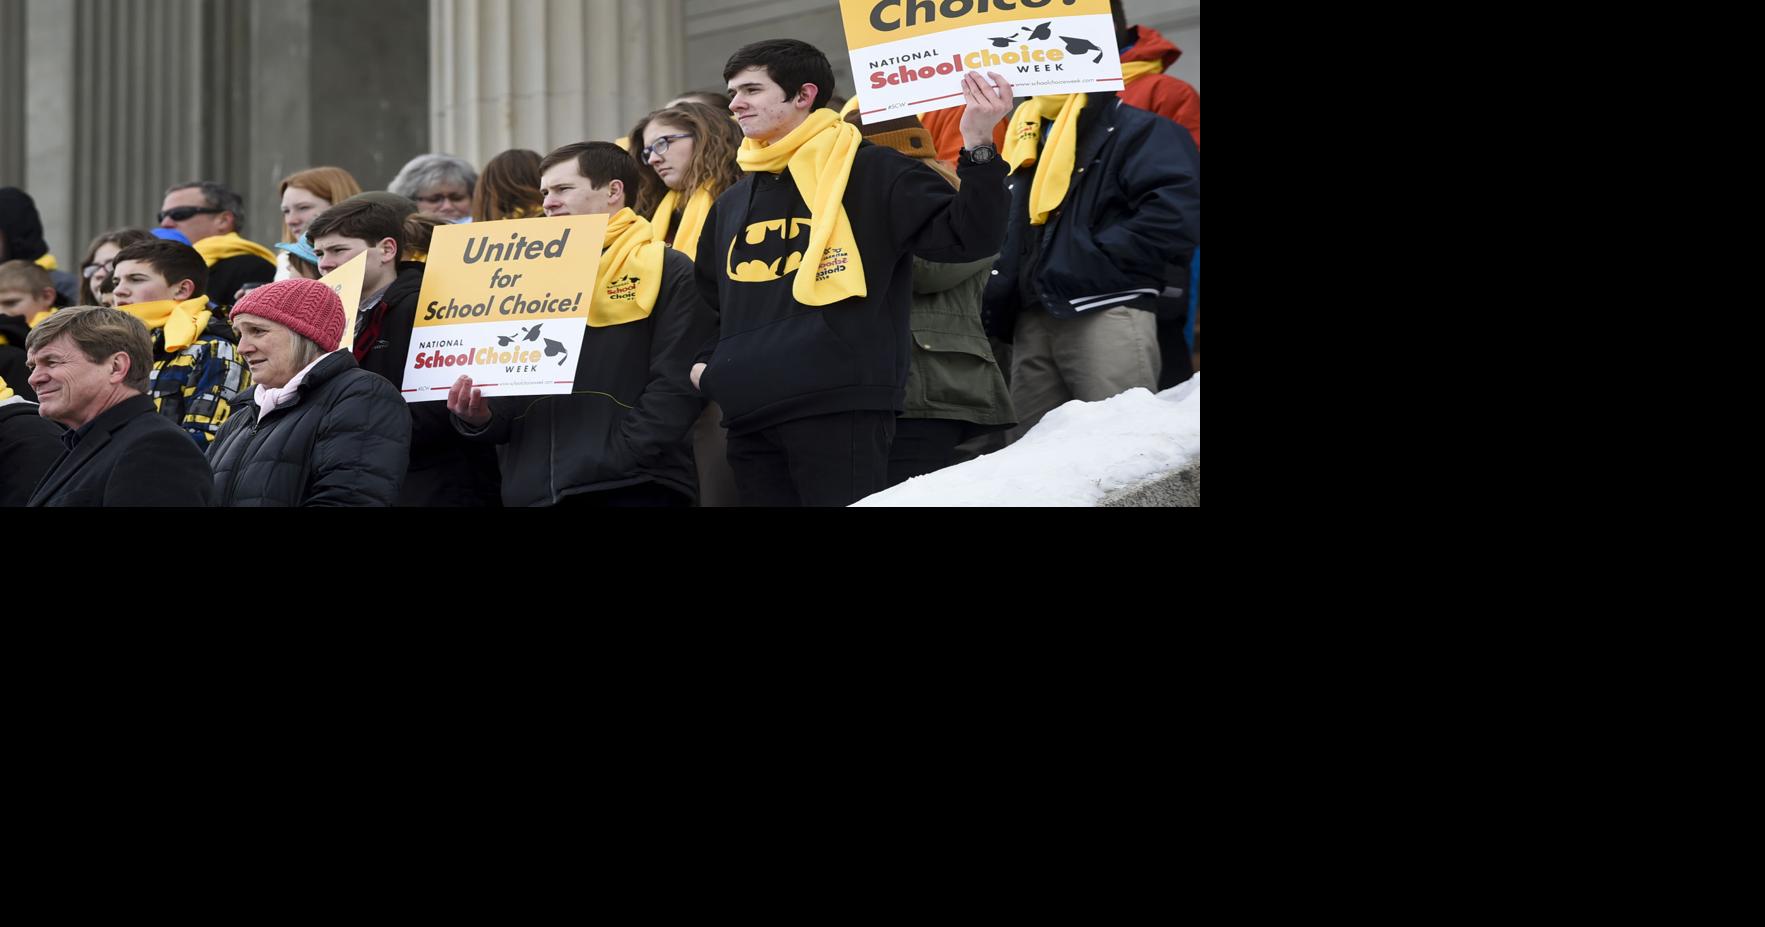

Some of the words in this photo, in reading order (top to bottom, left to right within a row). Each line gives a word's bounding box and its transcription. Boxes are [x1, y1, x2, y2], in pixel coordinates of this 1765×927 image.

[869, 49, 939, 69] NATIONAL
[1016, 63, 1064, 73] WEEK
[462, 228, 571, 264] United
[489, 268, 523, 289] for
[609, 291, 636, 300] Choic
[423, 295, 495, 321] School
[499, 292, 583, 316] Choice!
[419, 339, 464, 349] NATIONAL
[505, 365, 538, 373] WEEK
